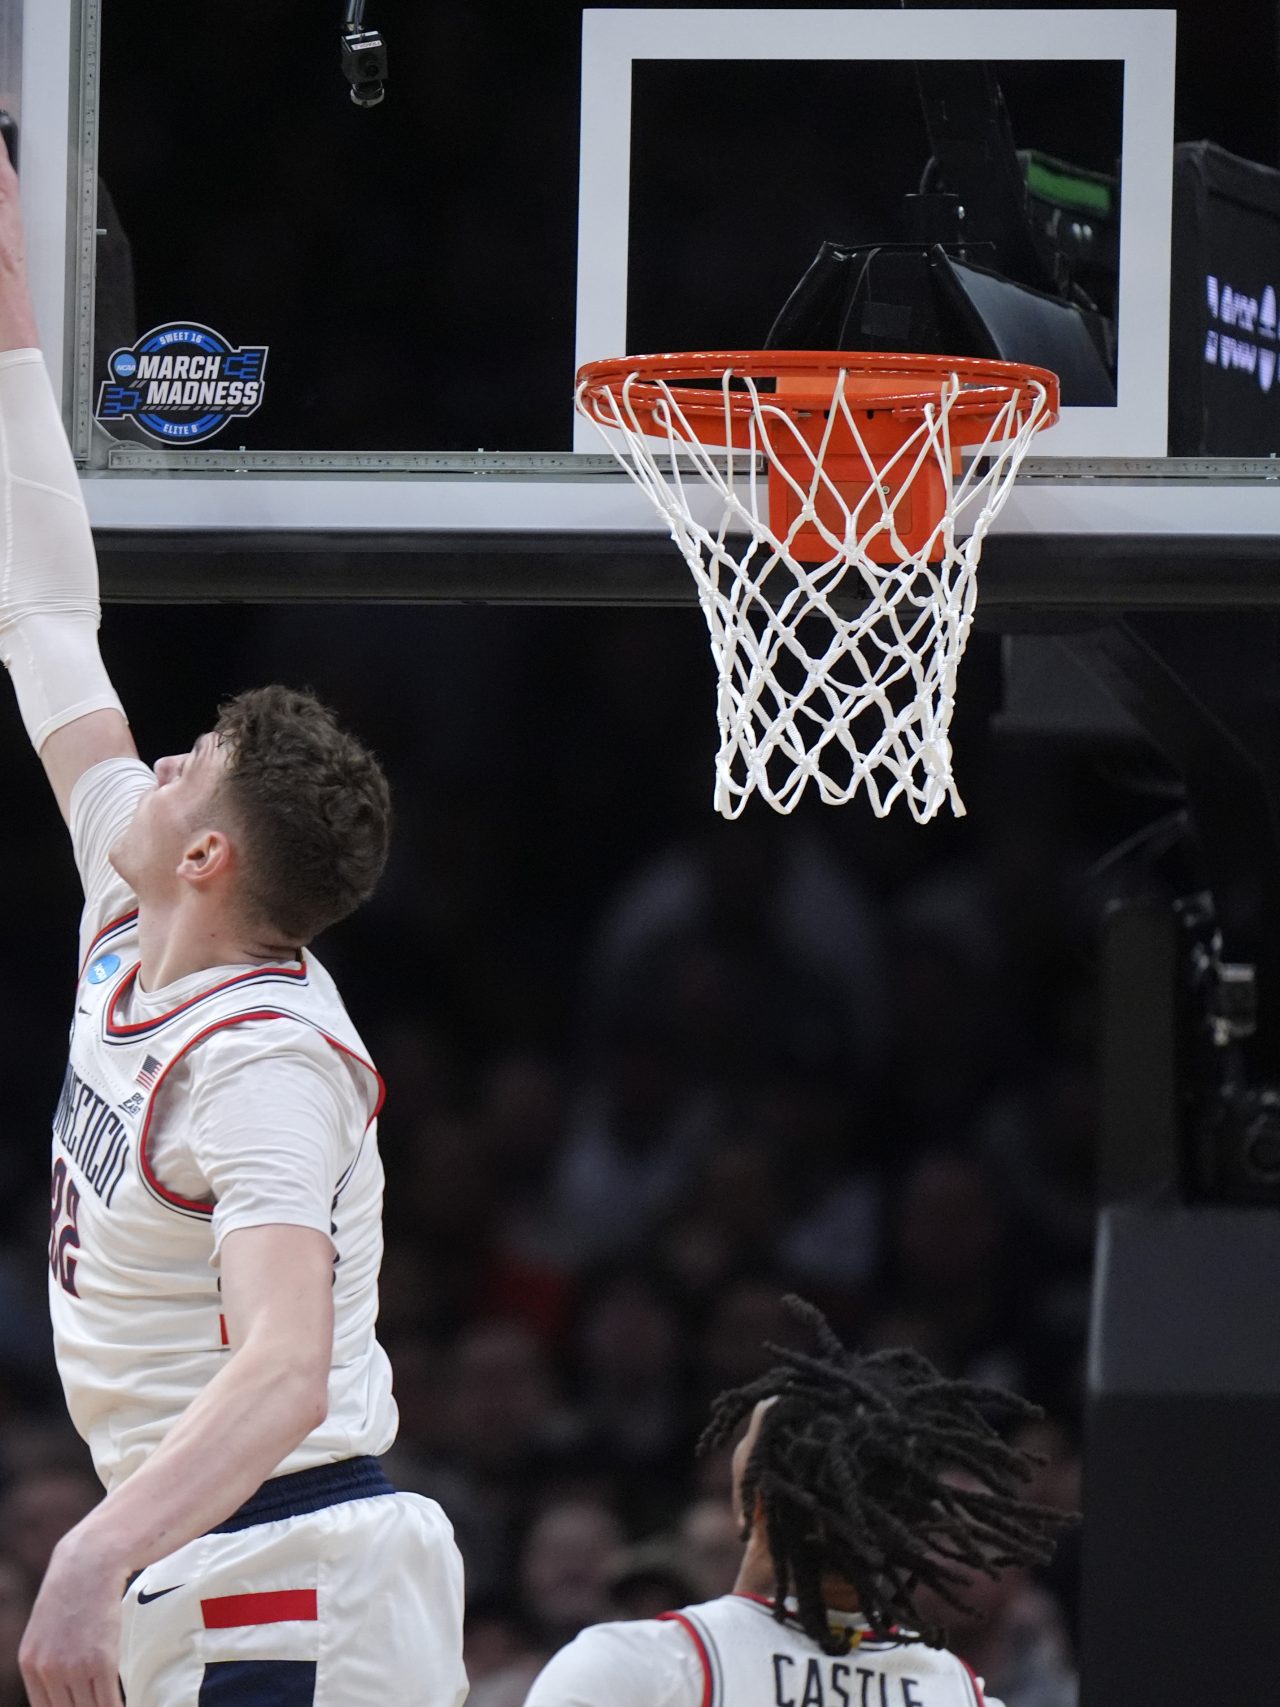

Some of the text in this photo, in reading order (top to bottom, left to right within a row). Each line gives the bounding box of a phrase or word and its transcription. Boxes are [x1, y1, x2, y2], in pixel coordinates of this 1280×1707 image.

[158, 331, 203, 345] SWEET 16
[116, 364, 137, 372] NCAA
[136, 355, 222, 380] MARCH
[145, 381, 260, 405] MADNESS
[162, 423, 198, 435] ELITE 8
